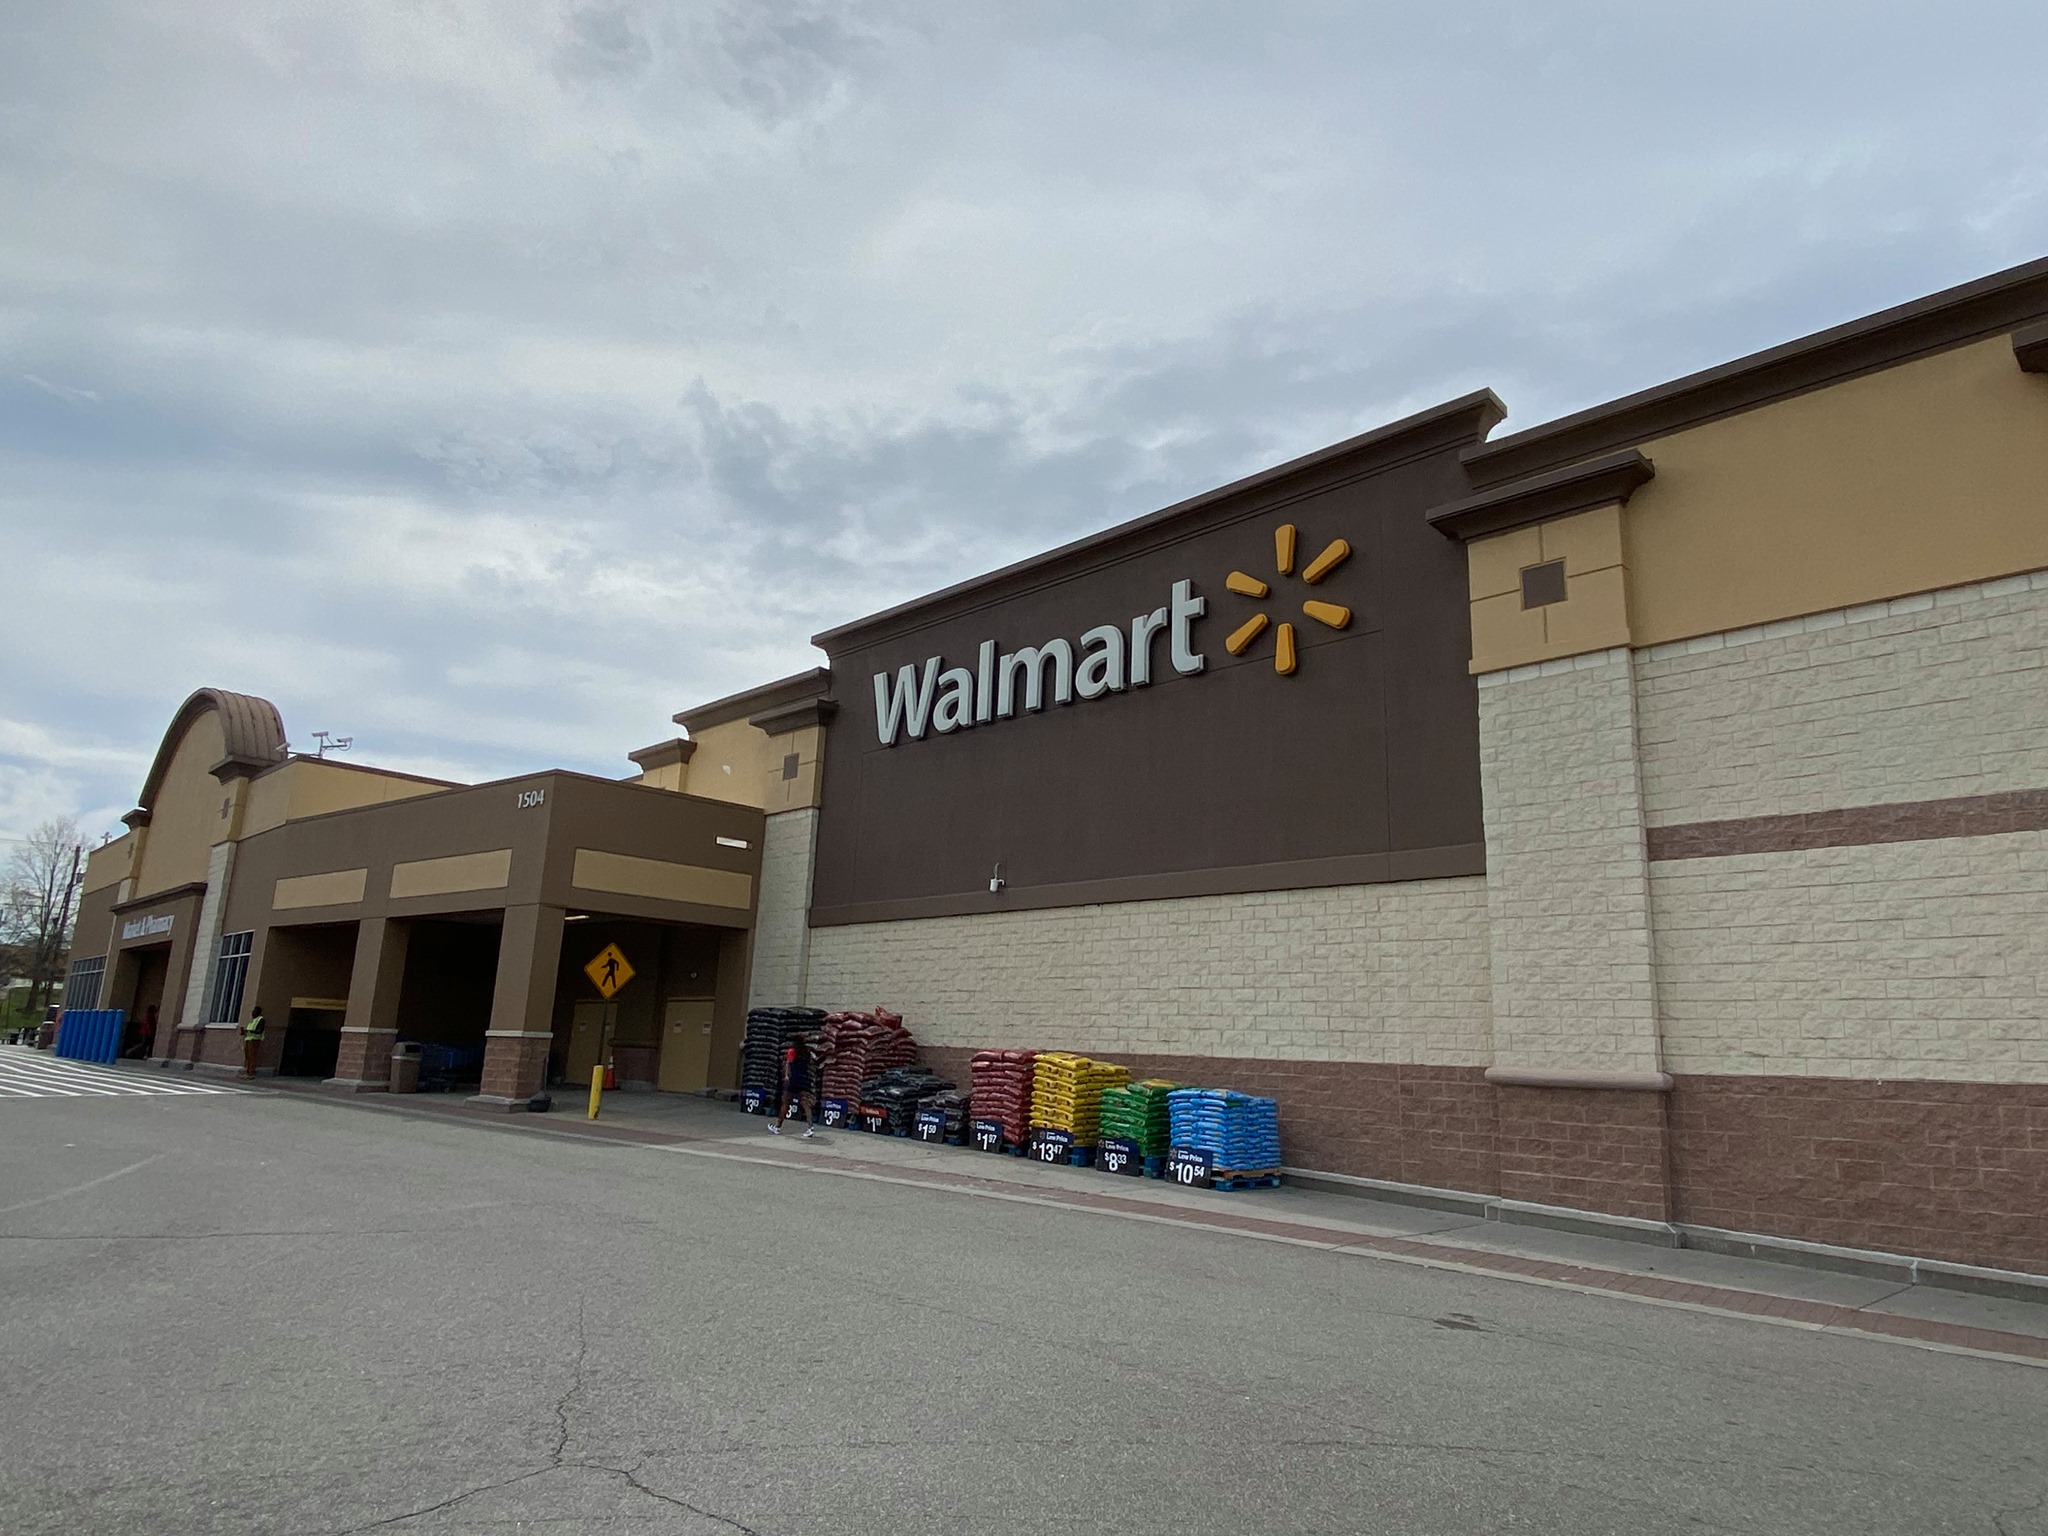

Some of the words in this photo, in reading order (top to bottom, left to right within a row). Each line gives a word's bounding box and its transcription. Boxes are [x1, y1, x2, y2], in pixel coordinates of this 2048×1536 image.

[873, 579, 1205, 746] Walmart
[517, 789, 545, 809] 1504
[1115, 1143, 1129, 1152] Price
[1177, 1152, 1189, 1161] Low
[1189, 1153, 1204, 1163] Price
